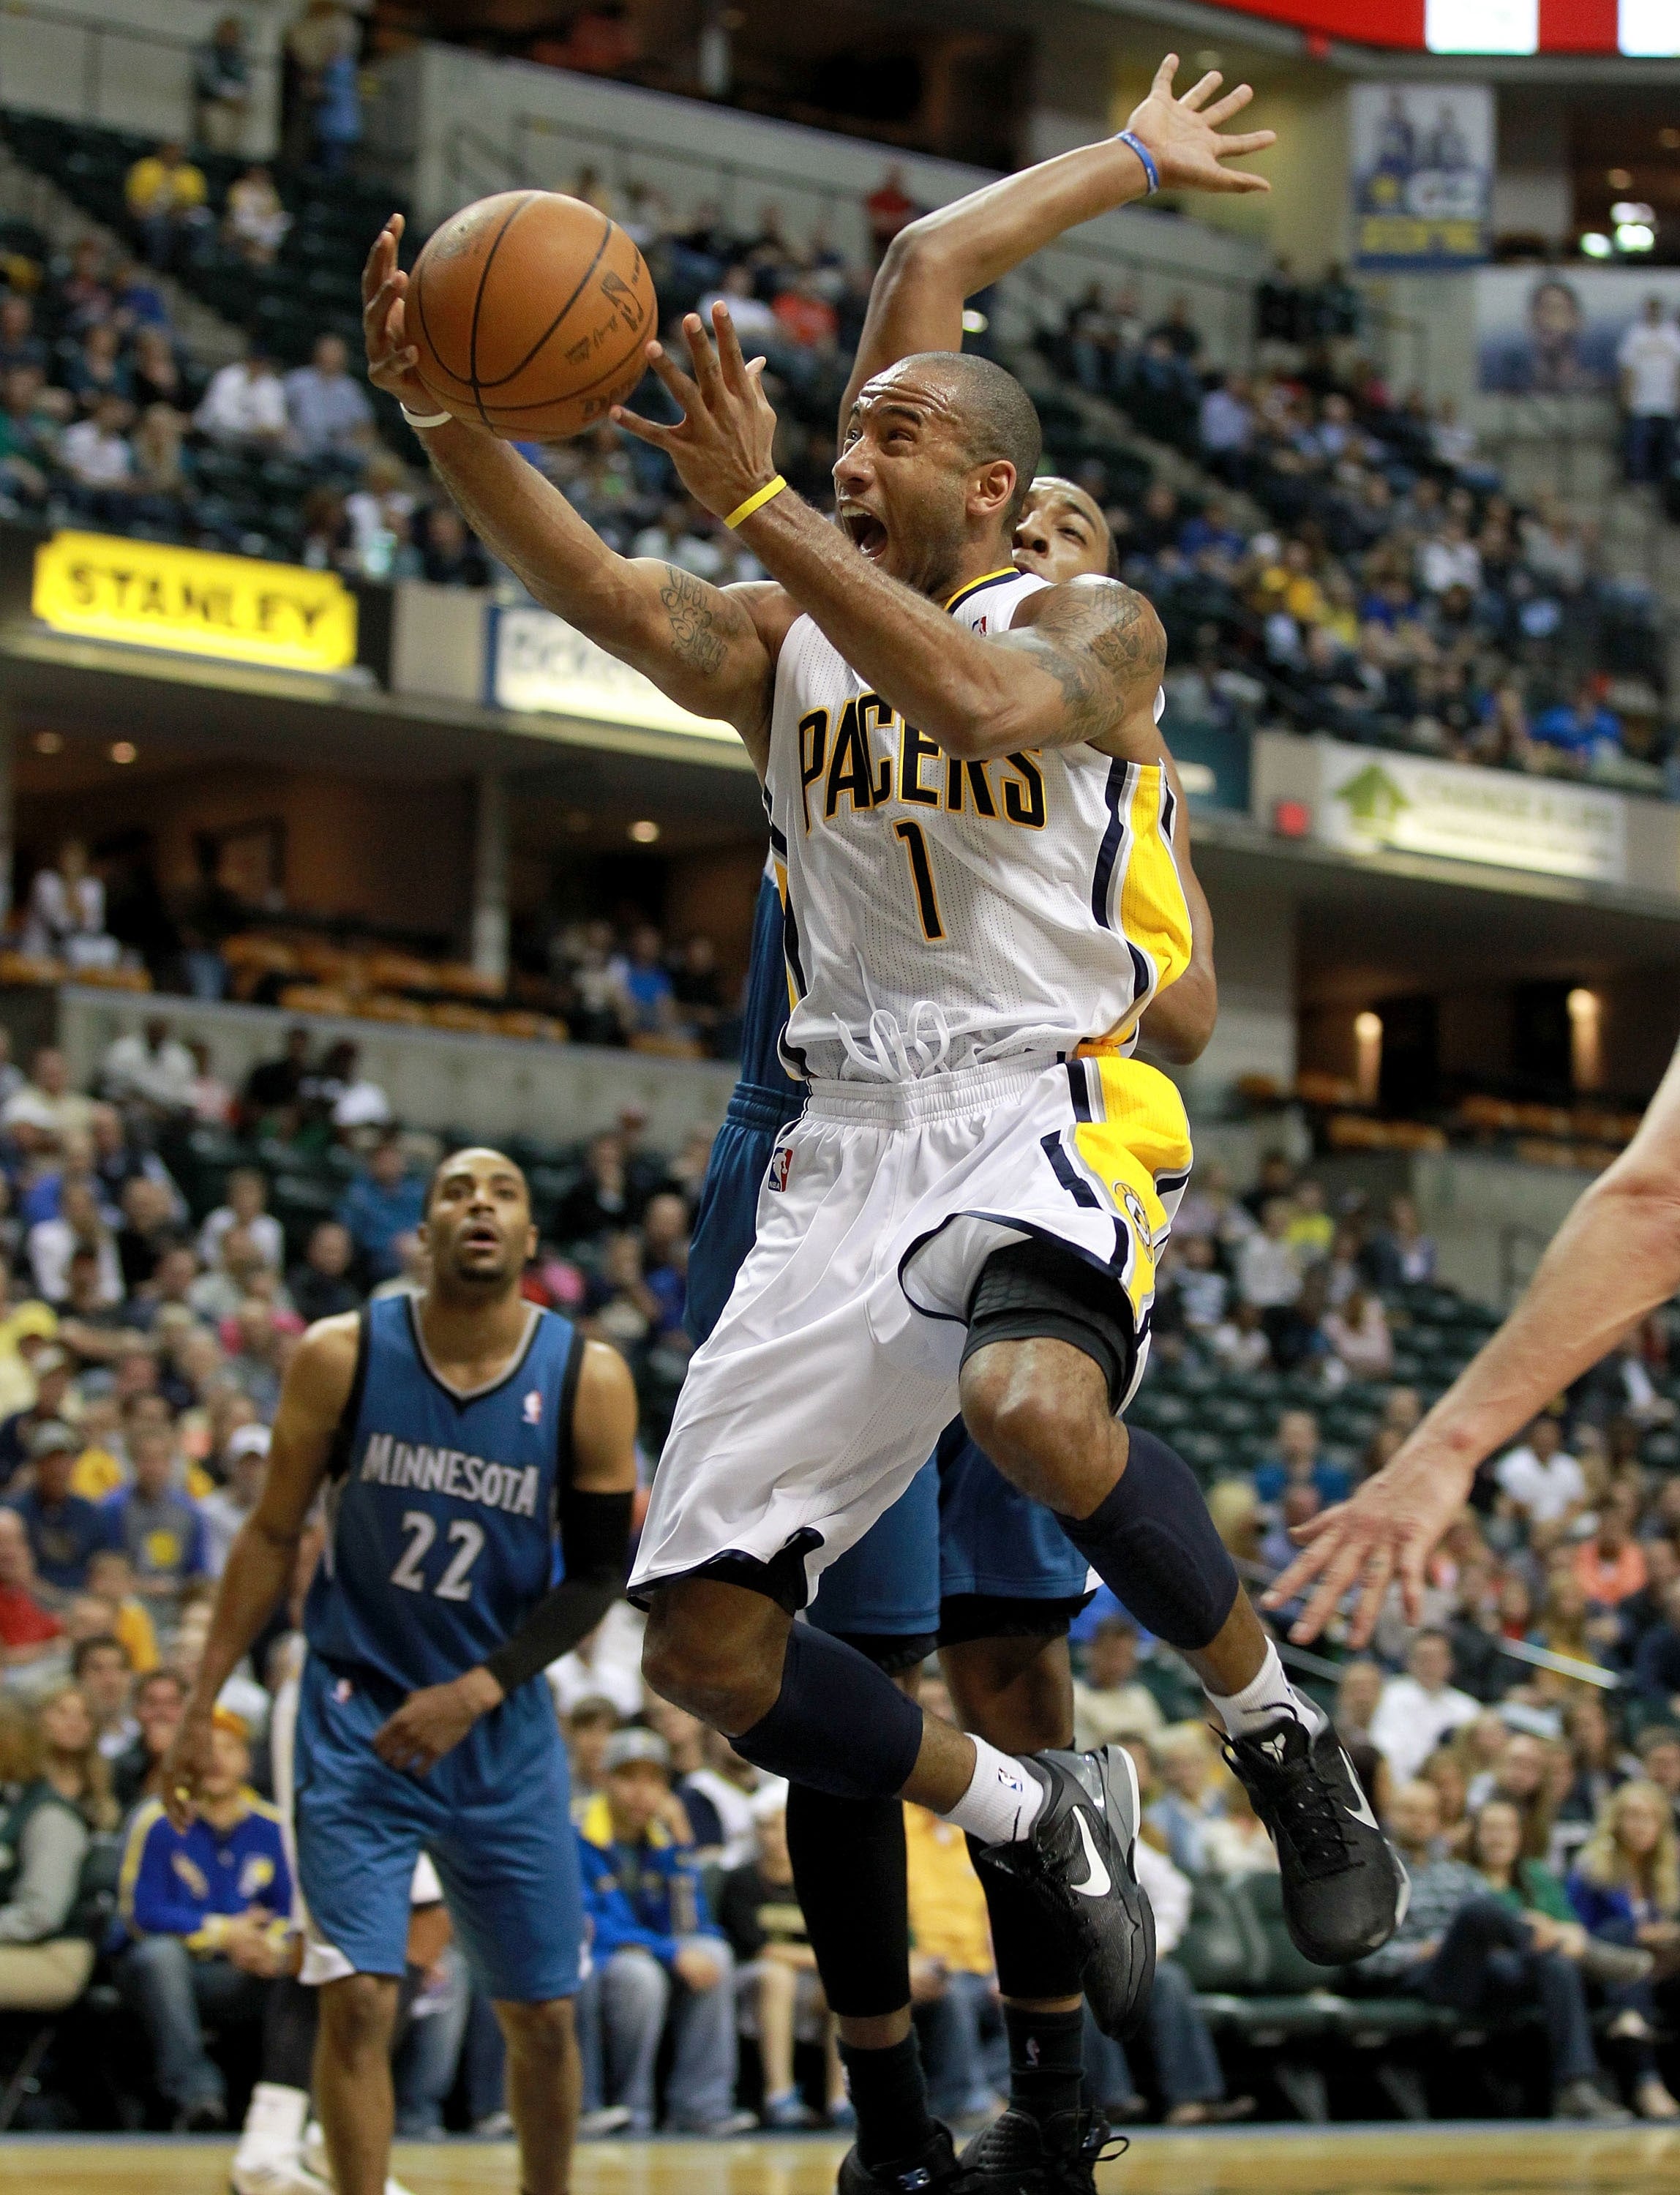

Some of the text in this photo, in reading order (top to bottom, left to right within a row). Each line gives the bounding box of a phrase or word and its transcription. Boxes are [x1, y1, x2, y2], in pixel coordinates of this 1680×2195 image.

[69, 561, 326, 638] STANLEY
[893, 818, 947, 942] 1
[768, 1180, 781, 1190] NBA
[361, 1433, 540, 1518] MINNESOTA
[390, 1510, 485, 1601] 22
